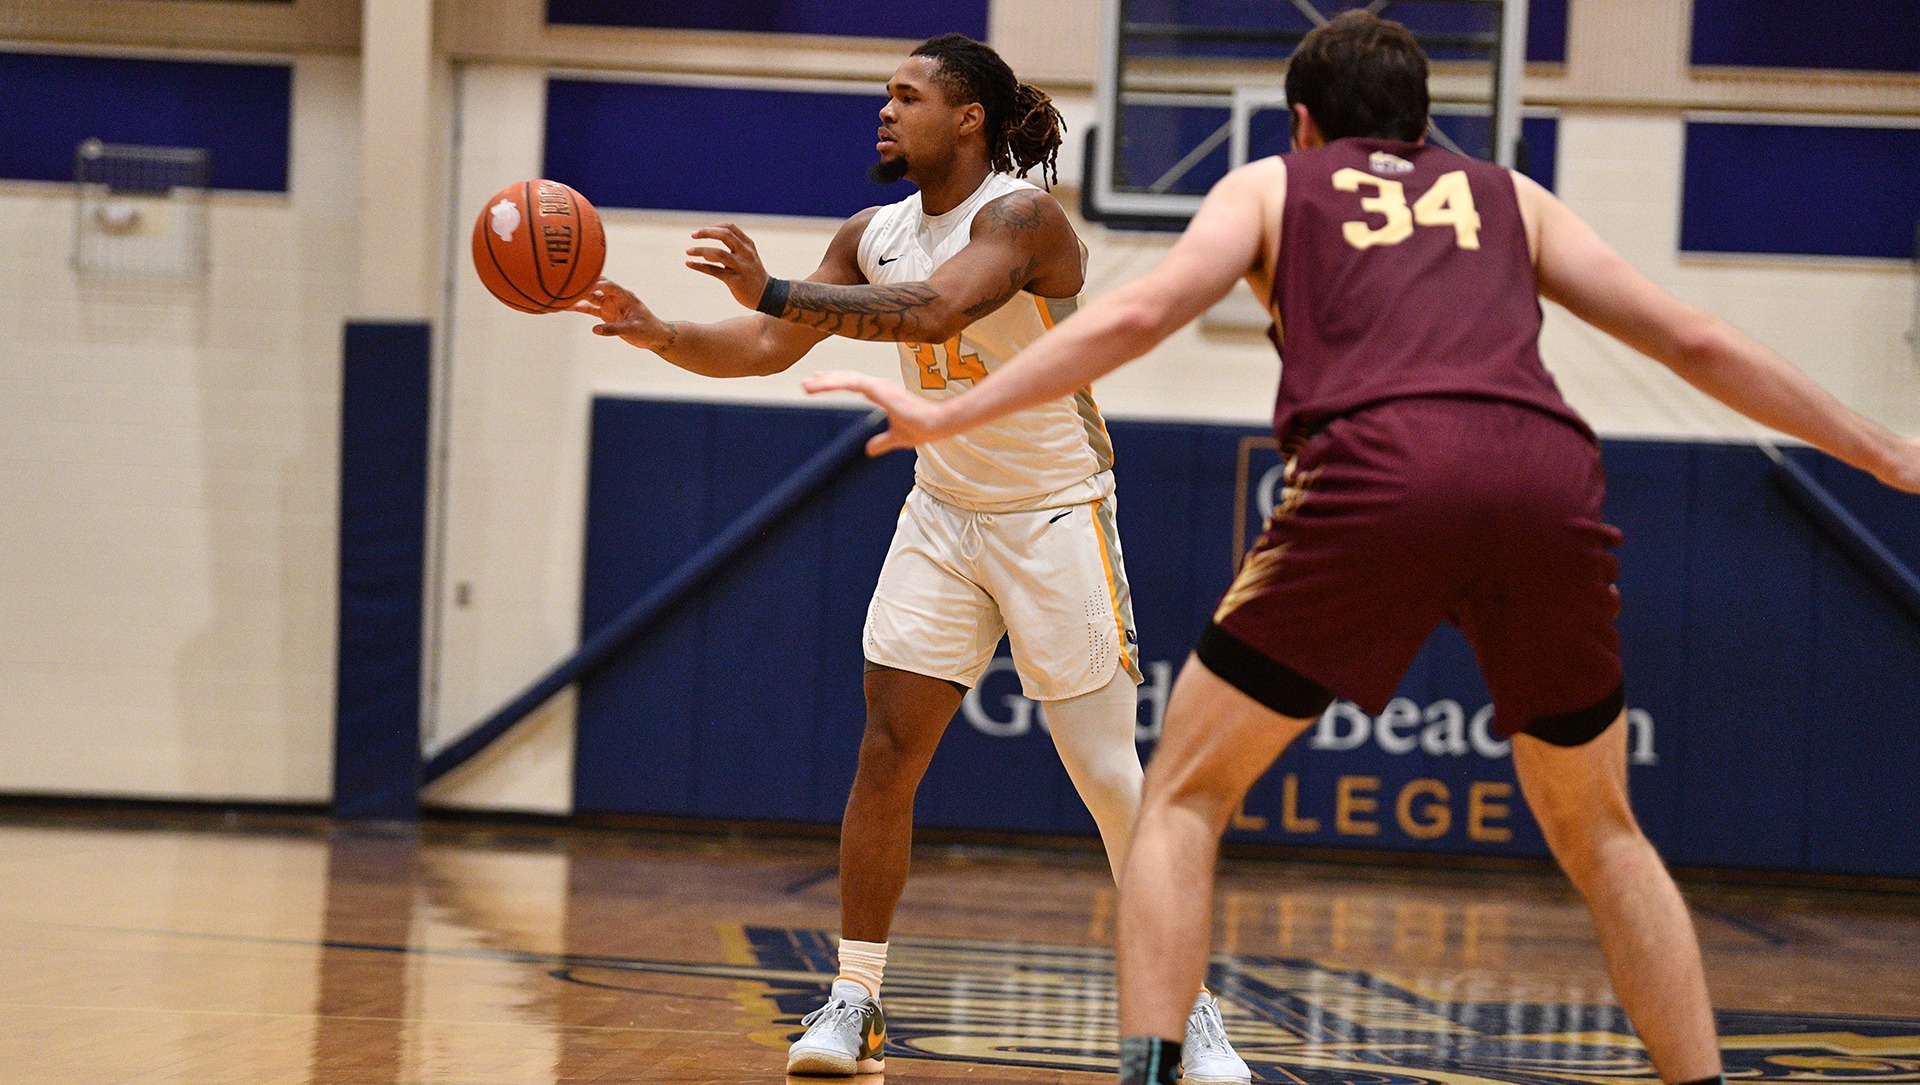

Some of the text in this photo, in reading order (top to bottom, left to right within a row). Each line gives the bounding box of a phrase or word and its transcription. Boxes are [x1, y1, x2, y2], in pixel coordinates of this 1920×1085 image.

[1331, 167, 1481, 250] 34
[543, 225, 572, 267] THE
[1232, 772, 1514, 842] LLEGE
